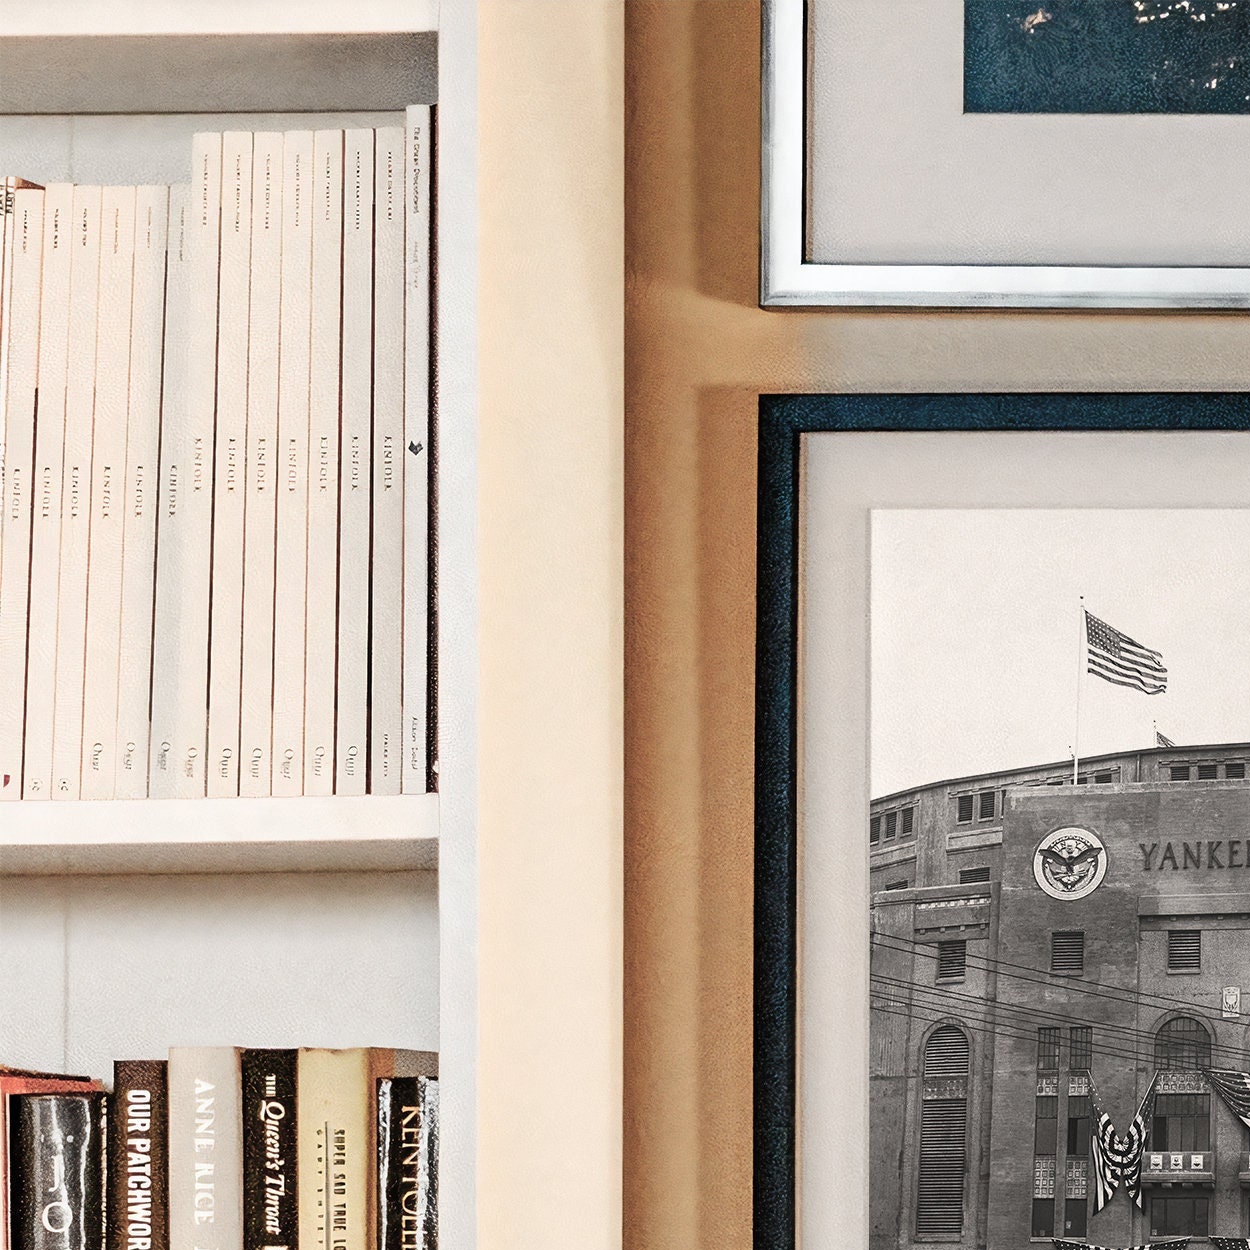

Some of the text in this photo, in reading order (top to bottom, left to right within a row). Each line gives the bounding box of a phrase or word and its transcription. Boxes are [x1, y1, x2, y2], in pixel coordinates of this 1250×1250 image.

[383, 436, 392, 491] KINFOLK
[127, 1089, 152, 1132] OUR
[193, 1077, 216, 1227] ANNE RICE
[259, 1099, 286, 1235] Queen's Throat
[333, 1128, 346, 1166] SUPER
[333, 1172, 346, 1195] SAD
[333, 1202, 346, 1231] TRUE
